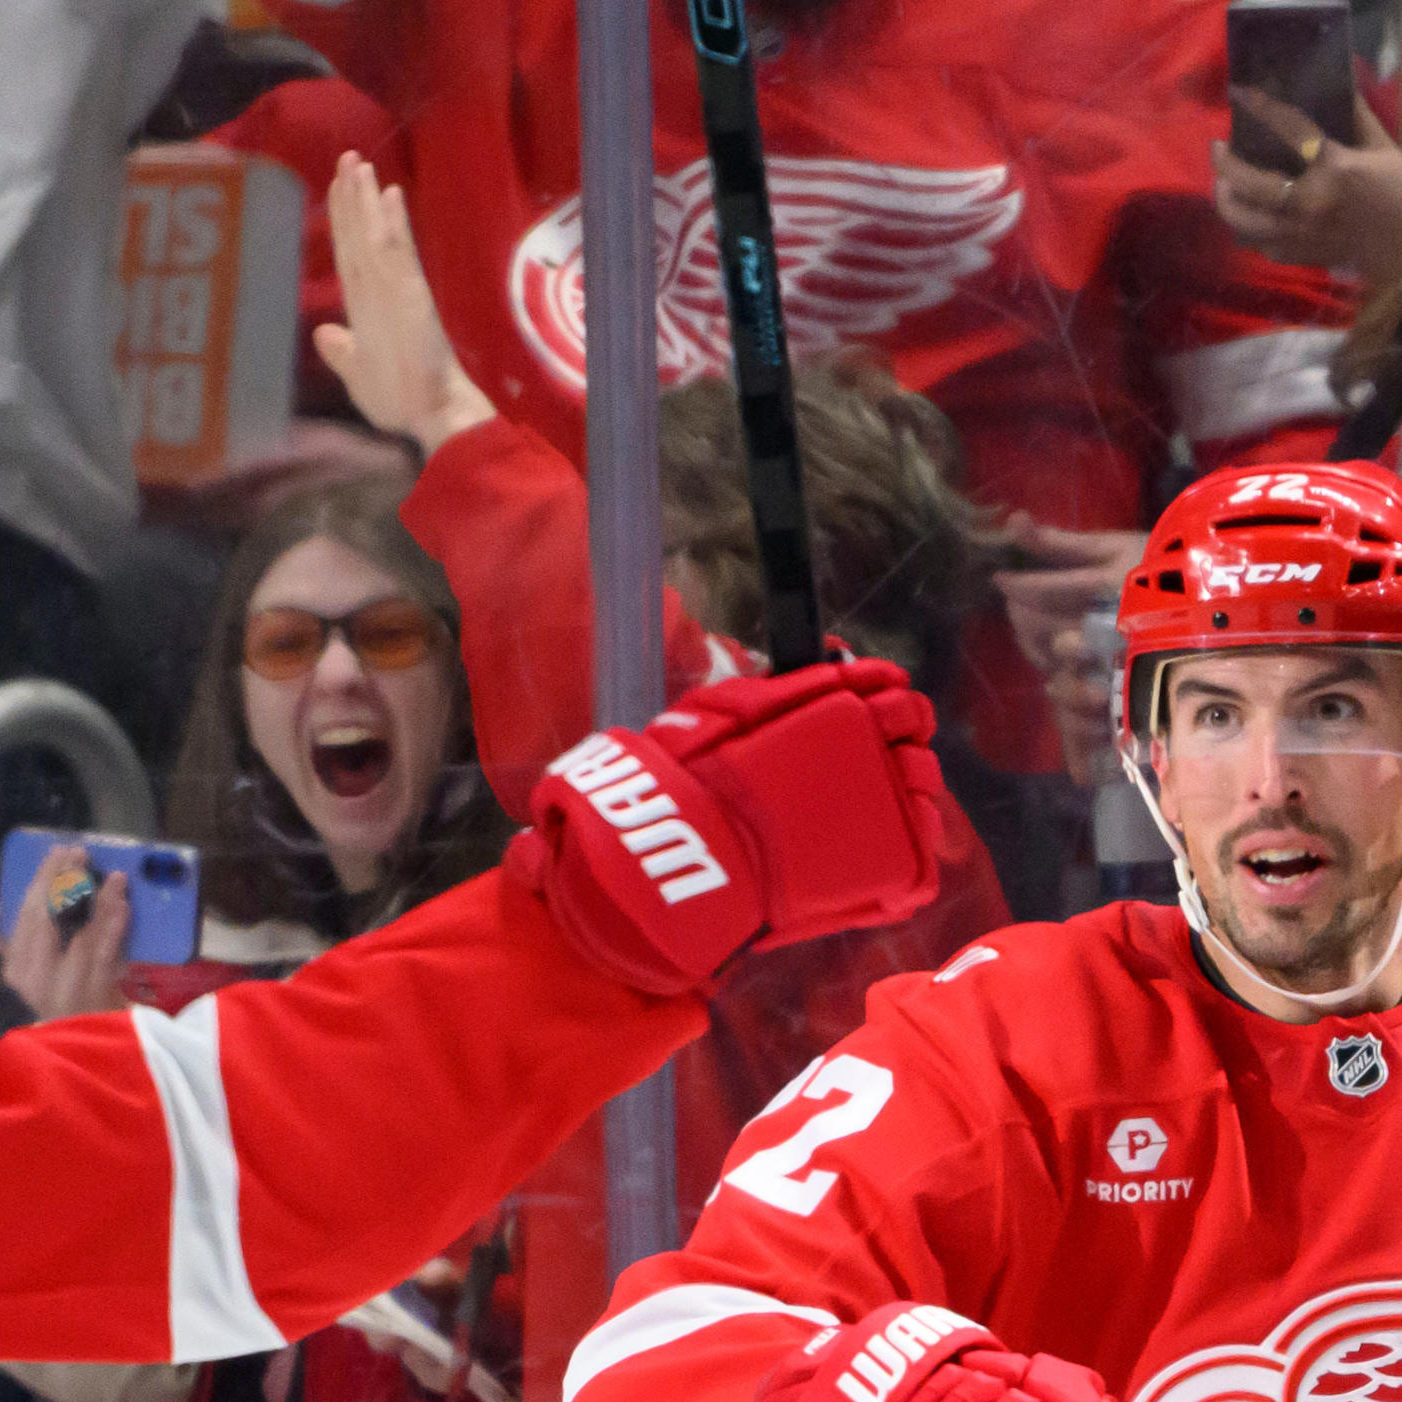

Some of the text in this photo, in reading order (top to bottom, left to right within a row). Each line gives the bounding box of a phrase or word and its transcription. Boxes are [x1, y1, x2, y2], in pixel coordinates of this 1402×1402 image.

[1229, 473, 1310, 504] 22
[1208, 563, 1322, 589] CCM
[705, 1053, 894, 1217] 2
[1086, 1177, 1194, 1203] PRIORITY
